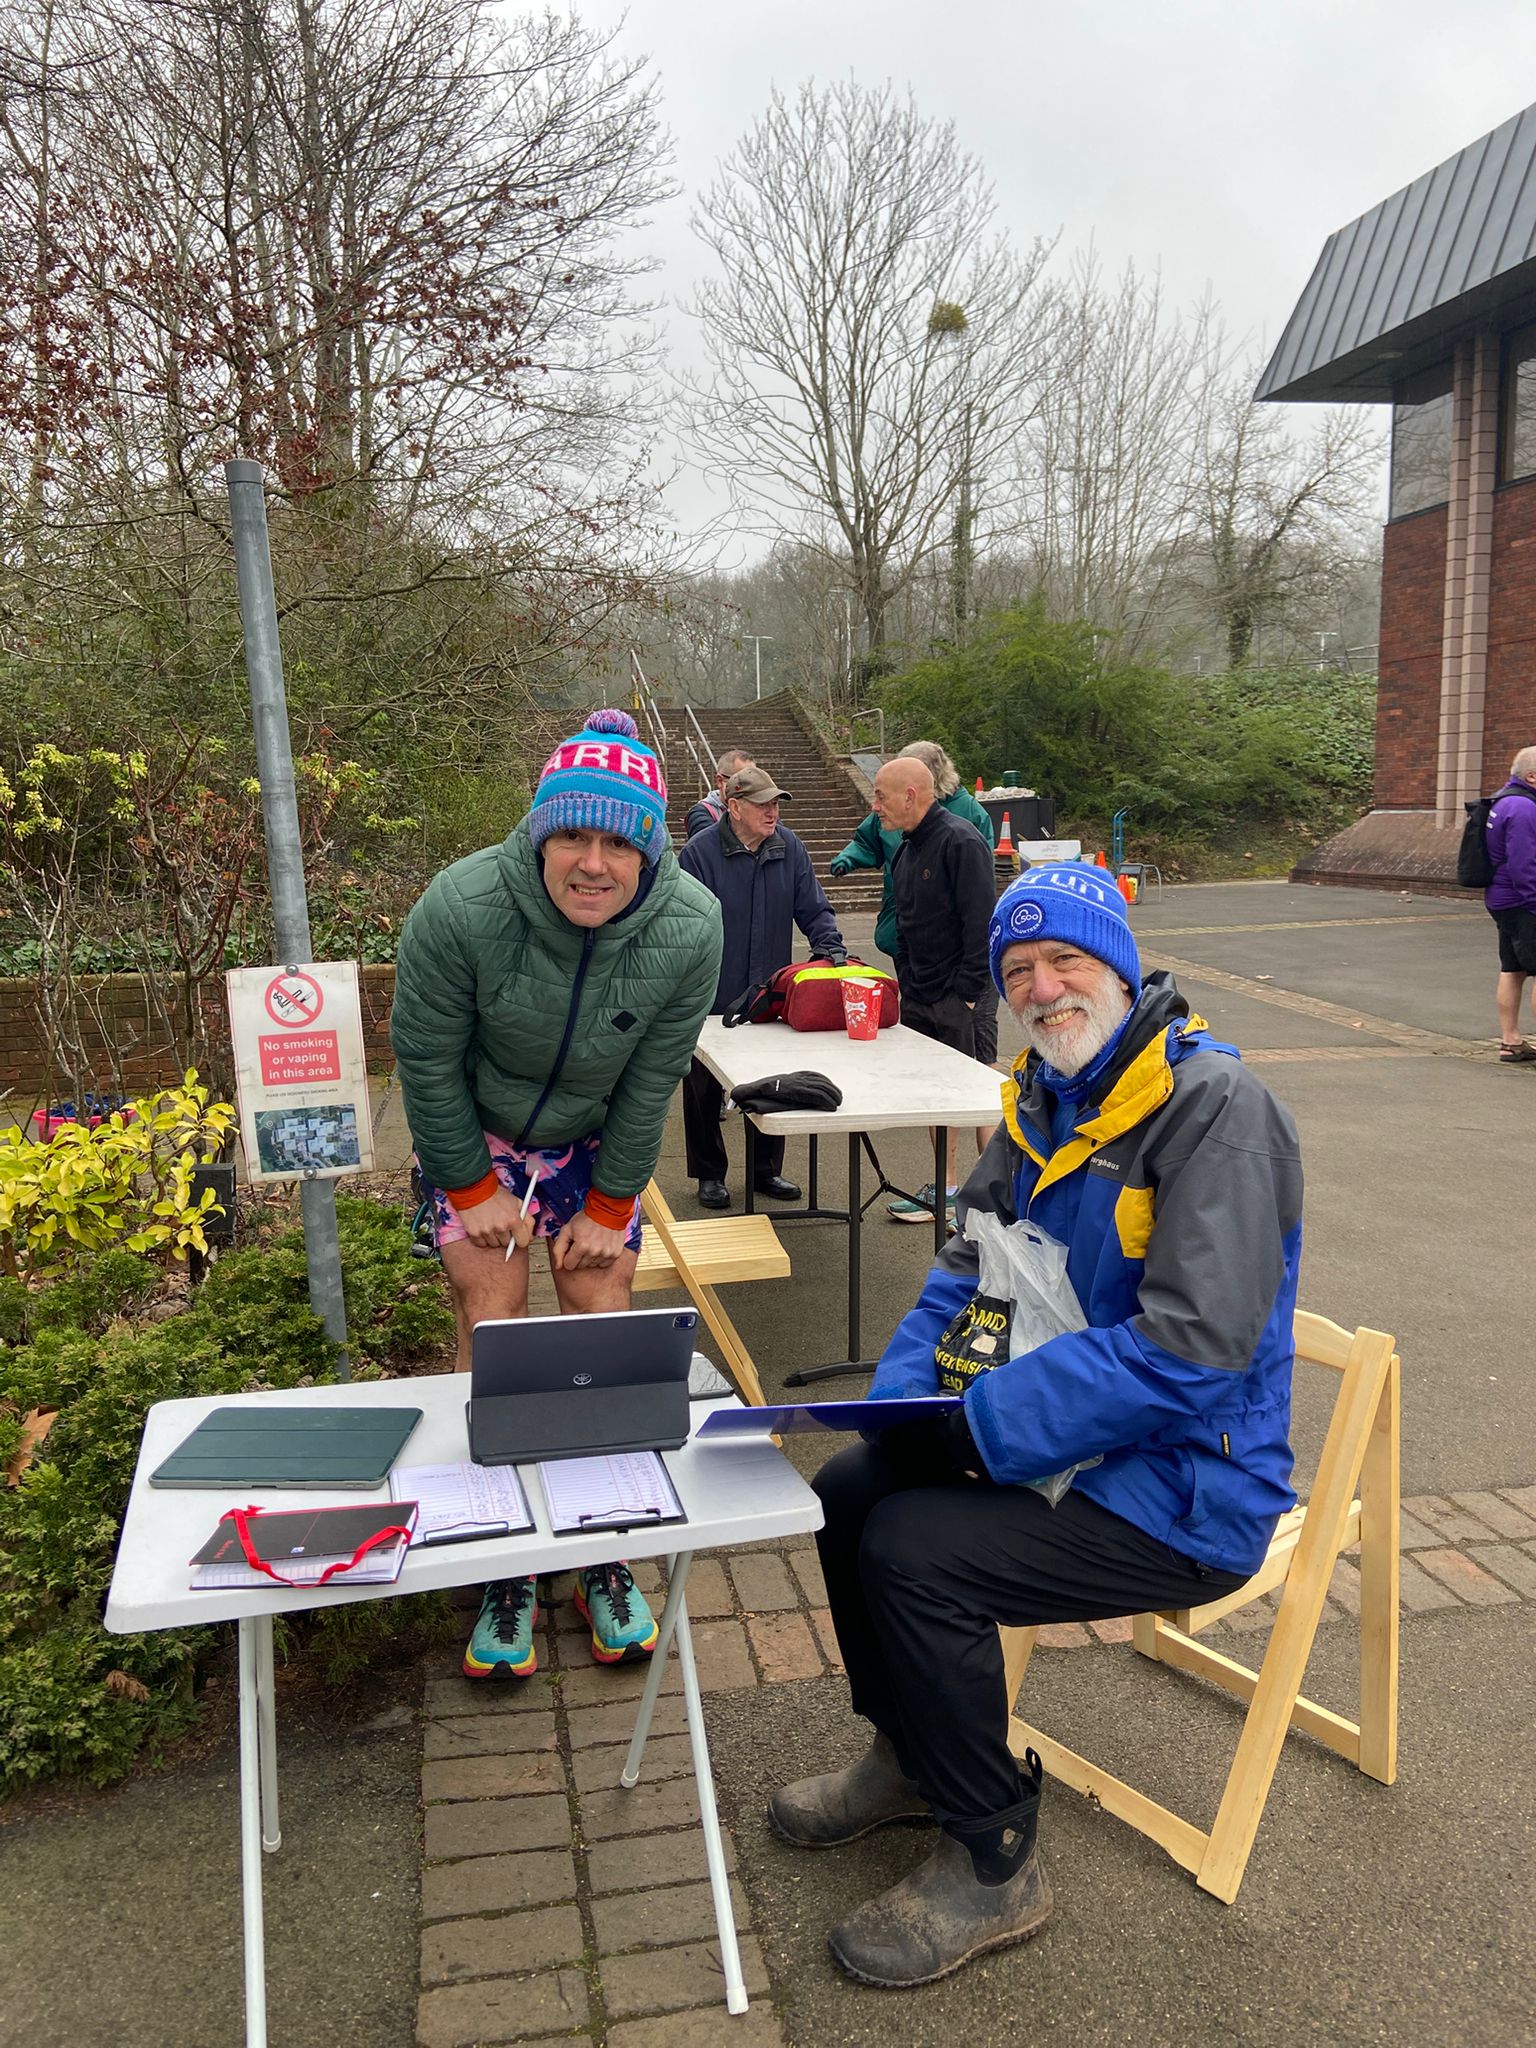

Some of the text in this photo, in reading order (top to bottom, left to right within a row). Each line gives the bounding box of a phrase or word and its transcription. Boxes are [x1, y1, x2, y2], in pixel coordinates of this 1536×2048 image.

[1020, 913, 1039, 924] 500
[1012, 922, 1041, 935] VOLUNTEER
[263, 1038, 333, 1051] No smoking
[272, 1052, 327, 1065] or vaping
[269, 1067, 333, 1079] in this area
[1090, 1156, 1120, 1171] erghaus
